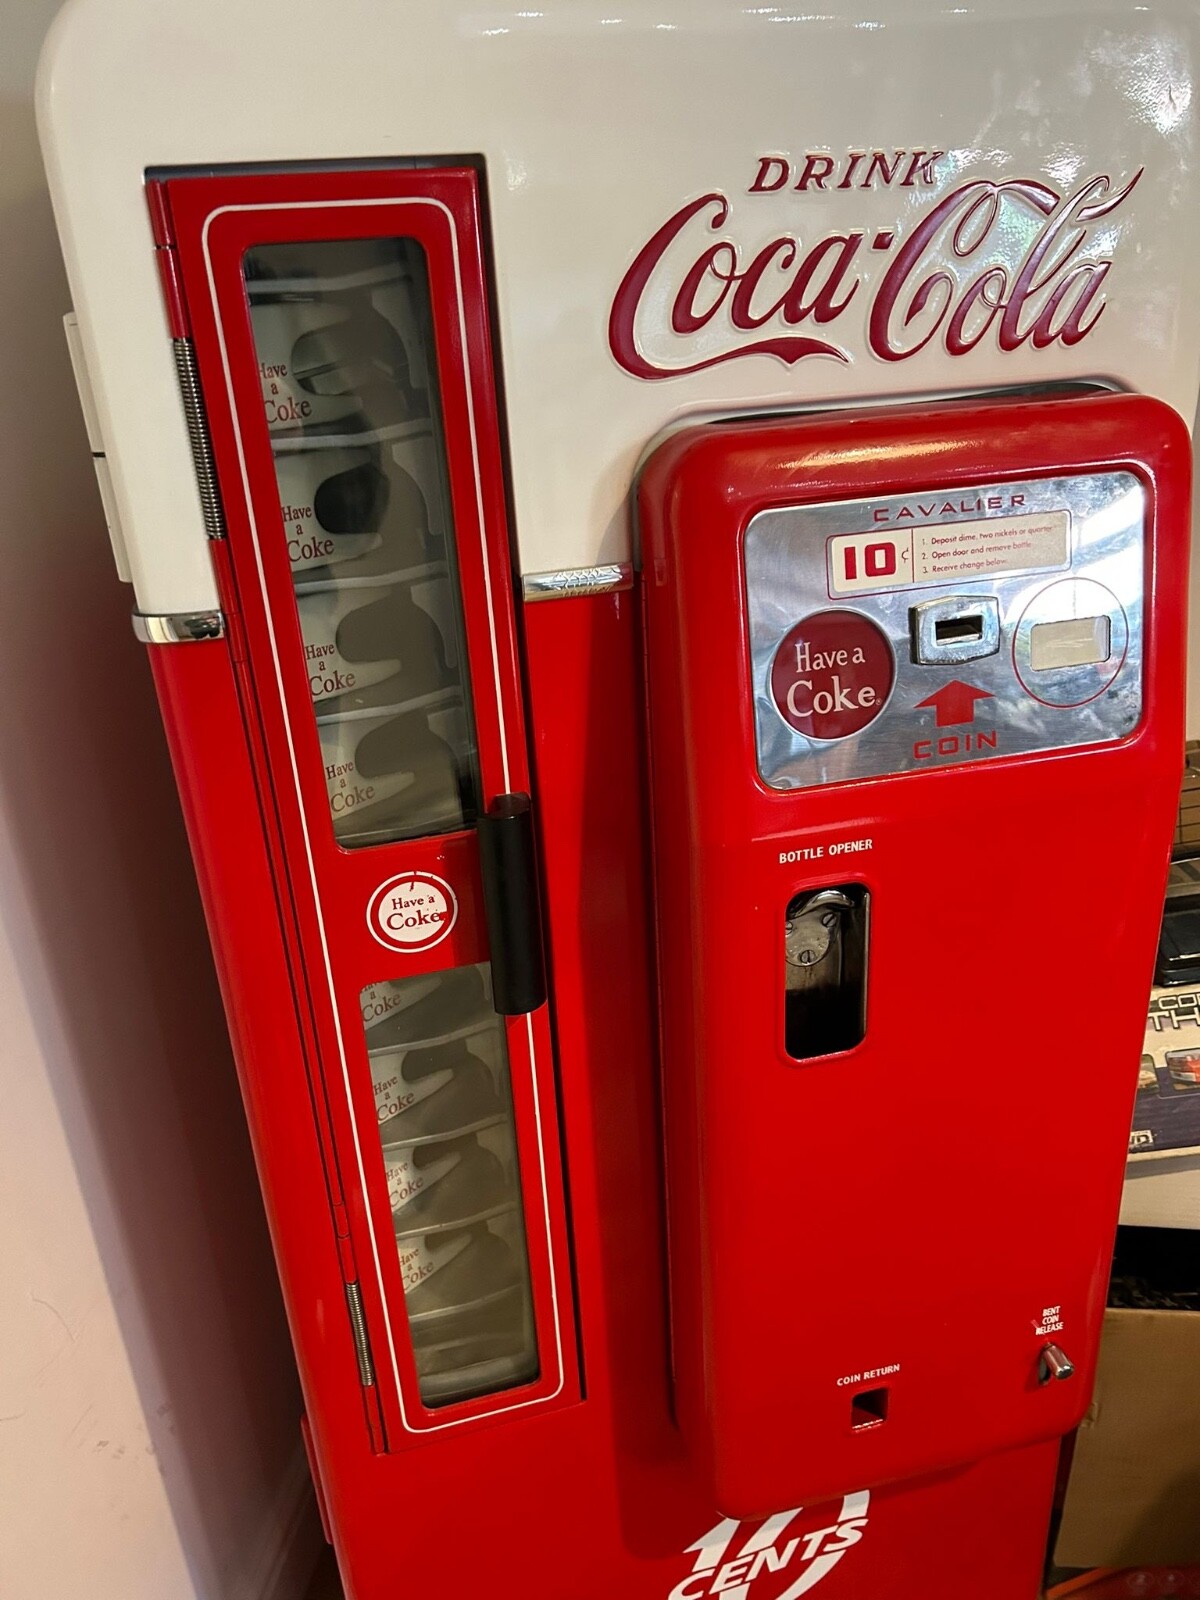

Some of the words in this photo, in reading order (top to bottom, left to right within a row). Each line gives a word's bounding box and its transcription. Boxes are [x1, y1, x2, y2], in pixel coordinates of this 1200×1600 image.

[749, 151, 945, 192] DRINK
[270, 382, 279, 395] a
[264, 396, 312, 424] Coke
[282, 505, 312, 522] Have
[874, 494, 1025, 522] CAVALIER
[296, 523, 303, 535] a
[931, 536, 957, 546] Deposit
[994, 528, 1017, 538] nickels
[287, 536, 334, 562] Coke
[932, 551, 950, 560] Open
[952, 548, 968, 557] door
[971, 546, 984, 554] and
[985, 544, 1011, 553] remove
[932, 565, 958, 573] Receive
[960, 560, 984, 569] change
[305, 643, 335, 660] Have
[795, 642, 848, 673] Have
[852, 647, 866, 664] a
[319, 660, 326, 671] a
[310, 670, 356, 696] Coke
[913, 730, 996, 760] COIN
[325, 761, 354, 780] Have
[339, 778, 347, 788] a
[331, 785, 376, 812] Coke
[779, 846, 824, 864] BOTTLE
[828, 839, 873, 856] OPENER
[392, 897, 424, 910] Have
[387, 909, 440, 930] Coke
[362, 995, 400, 1022] Coke
[373, 1076, 398, 1095] Have
[384, 1091, 391, 1100] a
[377, 1092, 415, 1120] Coke
[386, 1162, 408, 1179] Have
[390, 1177, 423, 1208] Coke
[1042, 1305, 1061, 1317] BENT
[1042, 1314, 1059, 1325] COIN
[1036, 1322, 1064, 1335] RELEASE
[837, 1373, 861, 1386] COIN
[863, 1364, 900, 1380] RETURN
[668, 1519, 869, 1600] CENTS
